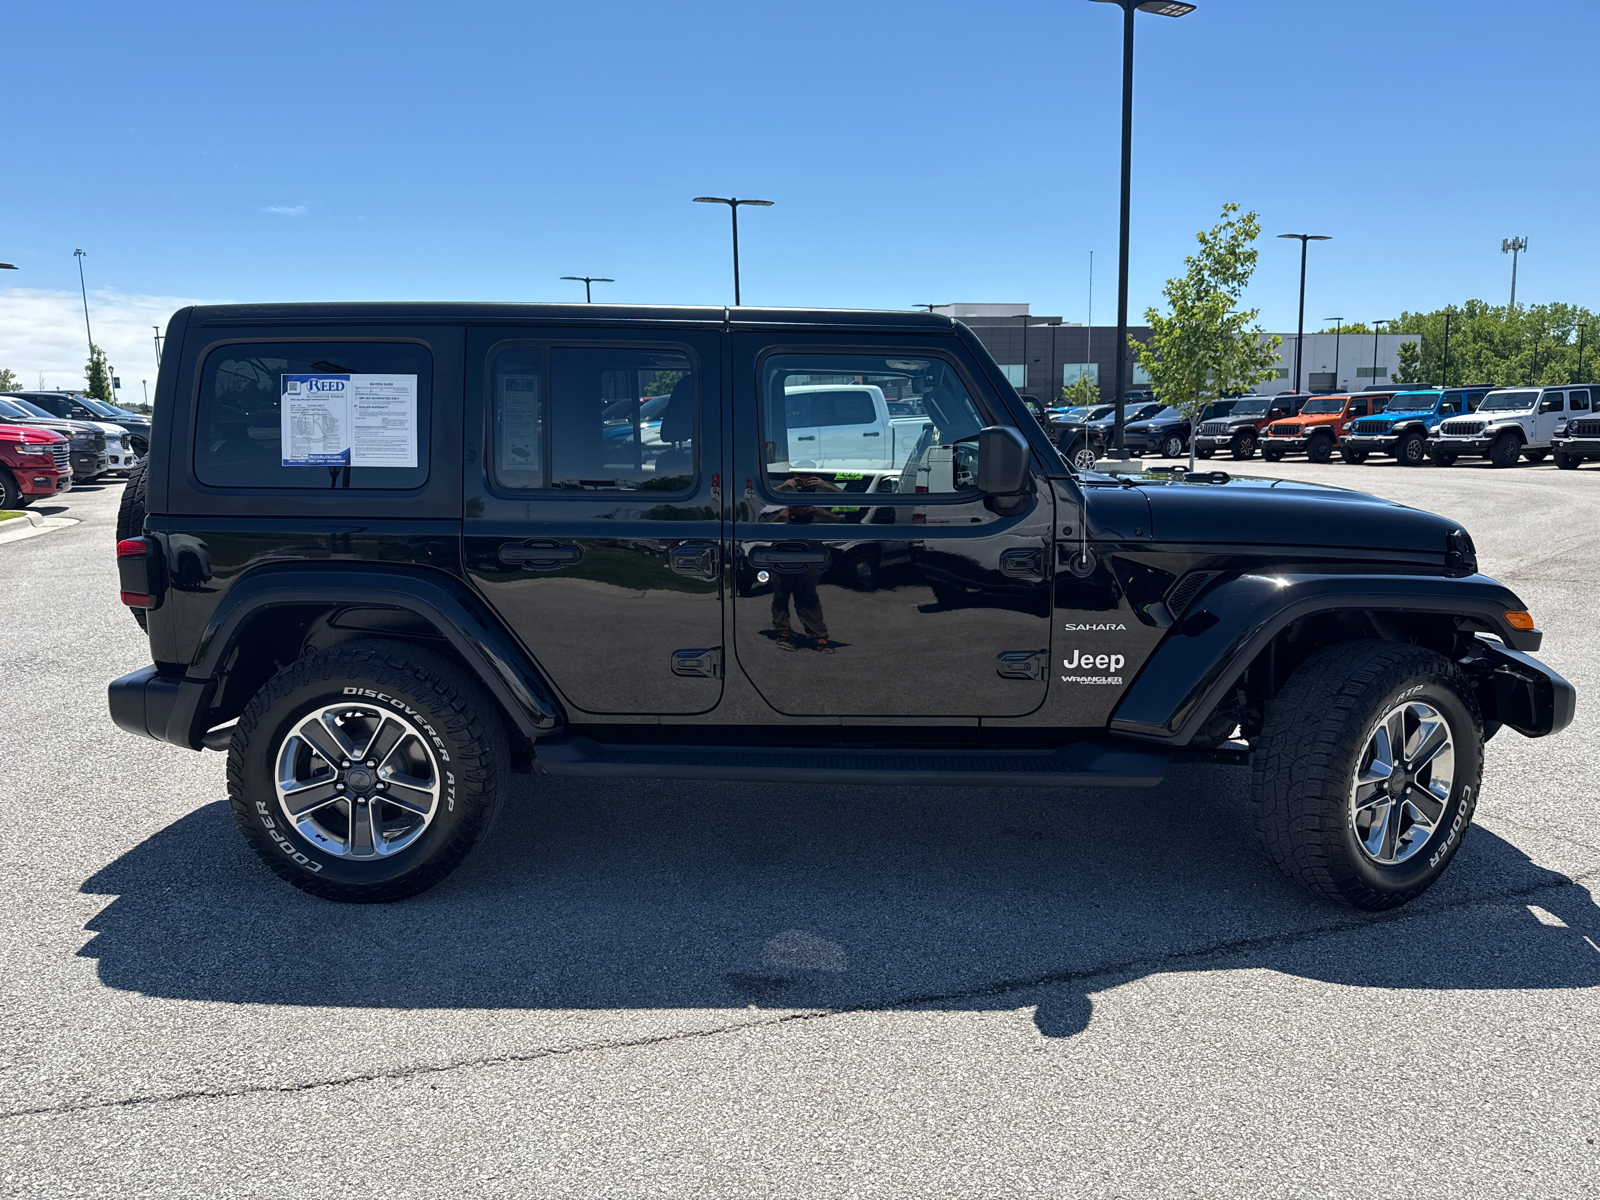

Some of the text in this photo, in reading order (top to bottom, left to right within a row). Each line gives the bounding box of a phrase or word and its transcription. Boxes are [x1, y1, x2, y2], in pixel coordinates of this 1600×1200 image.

[309, 379, 345, 391] REED
[1065, 623, 1127, 631] SAHARA
[1063, 649, 1125, 673] Jeep
[1395, 684, 1424, 703] ATP
[342, 686, 455, 813] DISCOVERER ATP
[255, 800, 323, 873] COOPER
[1429, 784, 1472, 868] COOPER
